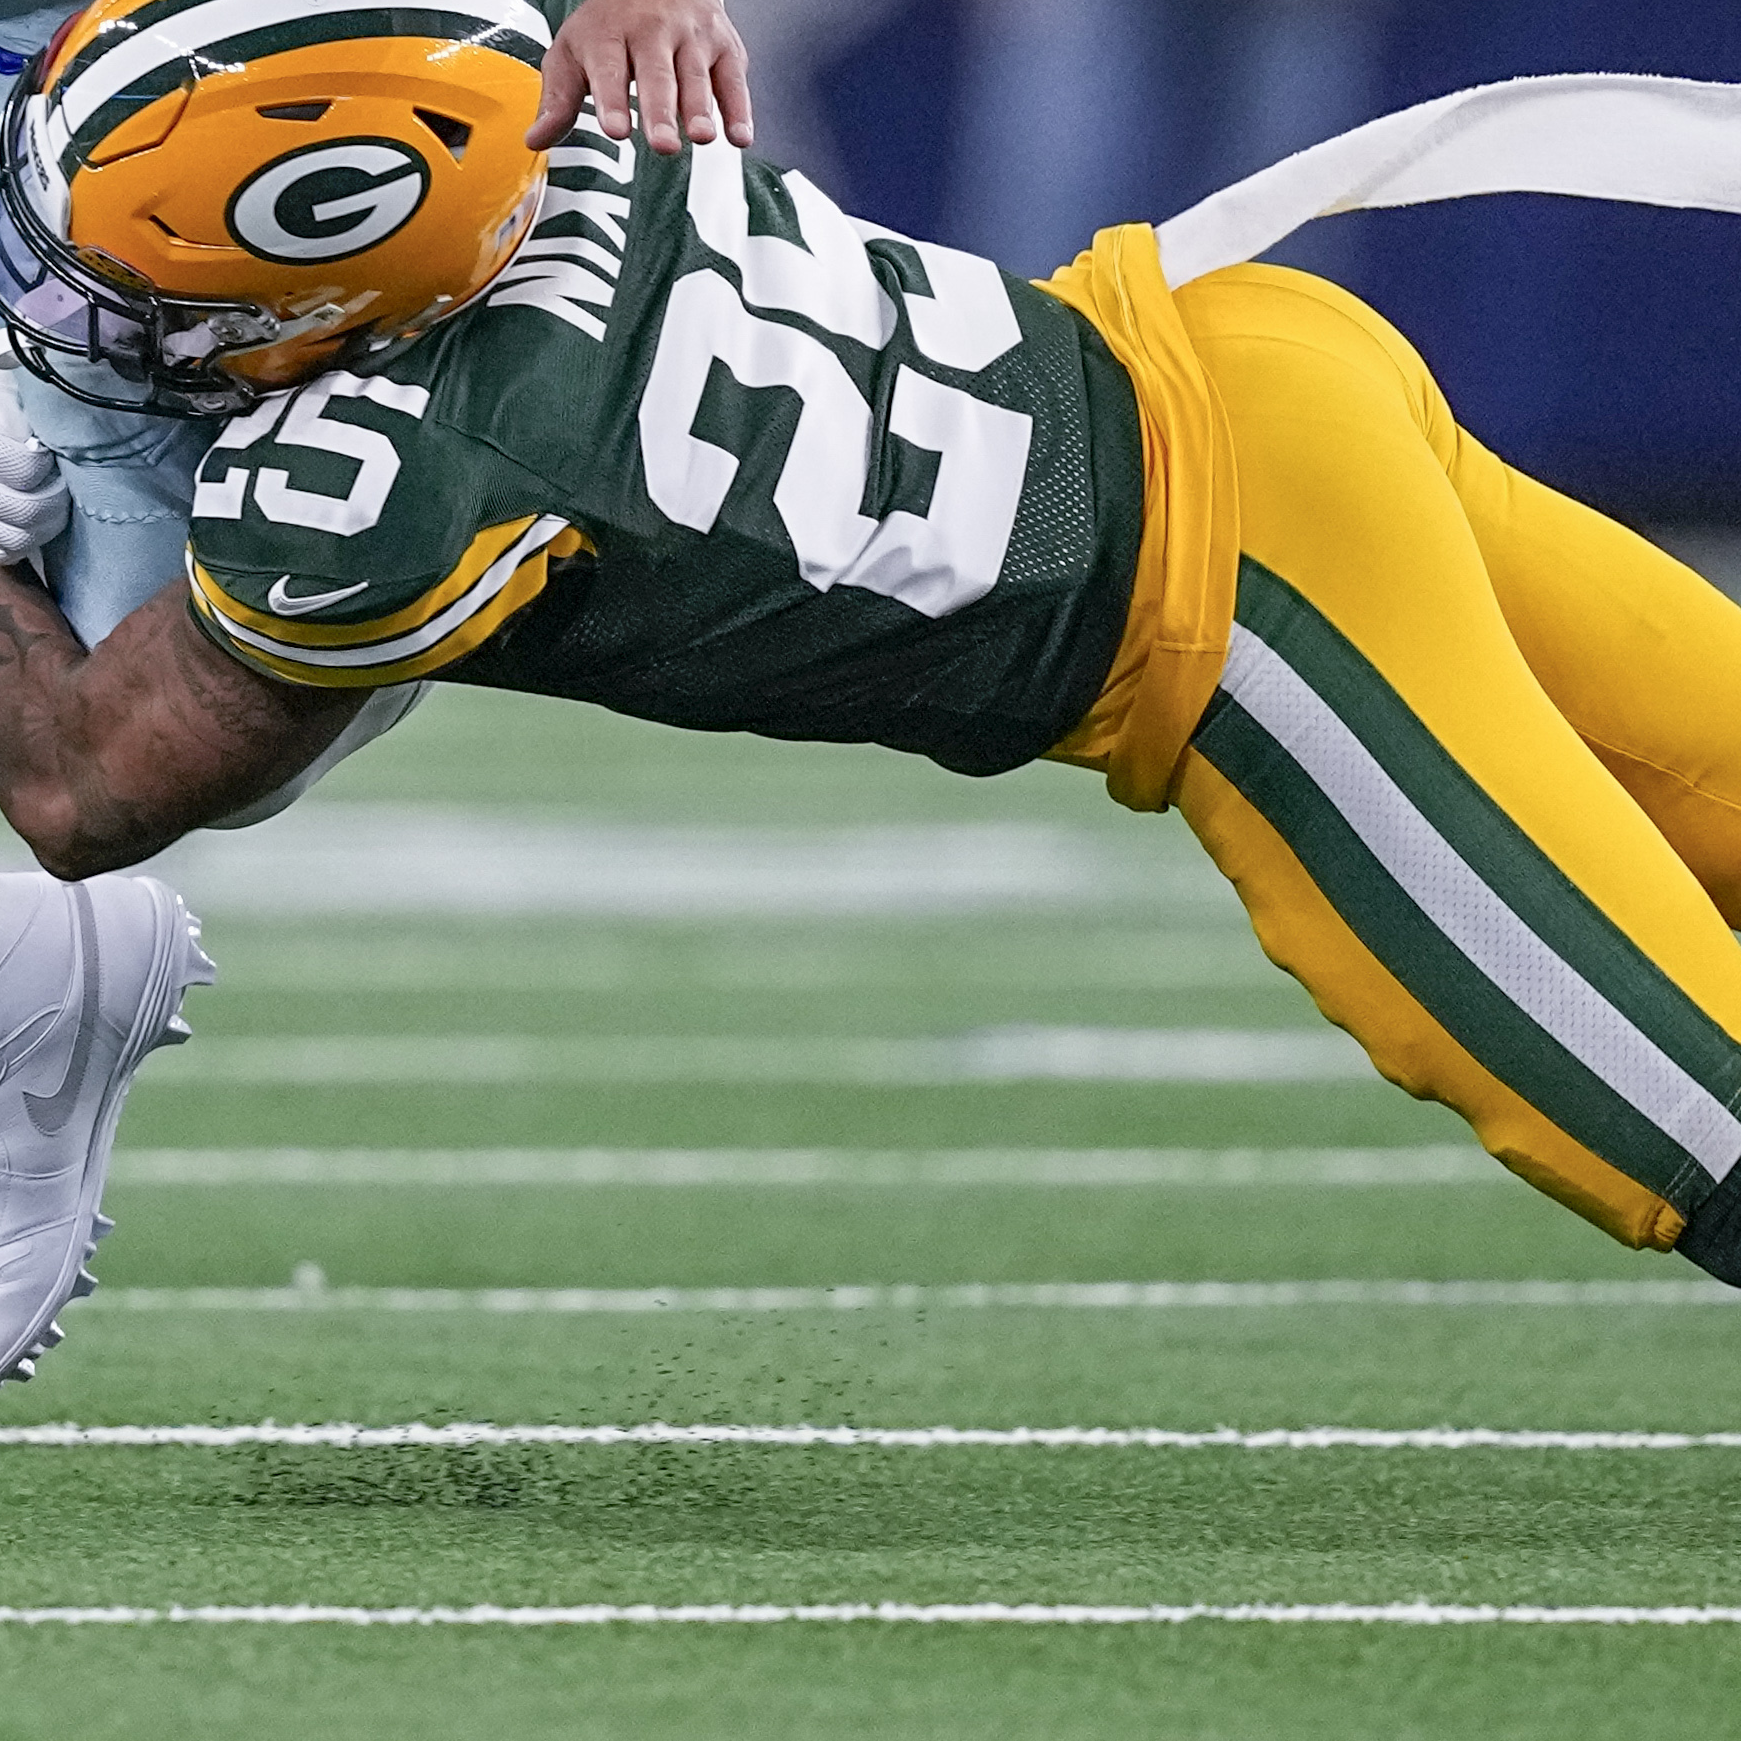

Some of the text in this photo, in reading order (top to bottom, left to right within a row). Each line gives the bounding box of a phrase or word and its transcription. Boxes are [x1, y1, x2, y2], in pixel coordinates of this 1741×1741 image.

[234, 143, 424, 259] G
[486, 80, 639, 343] NIXO
[191, 369, 432, 539] 25
[637, 93, 1034, 620] 25
